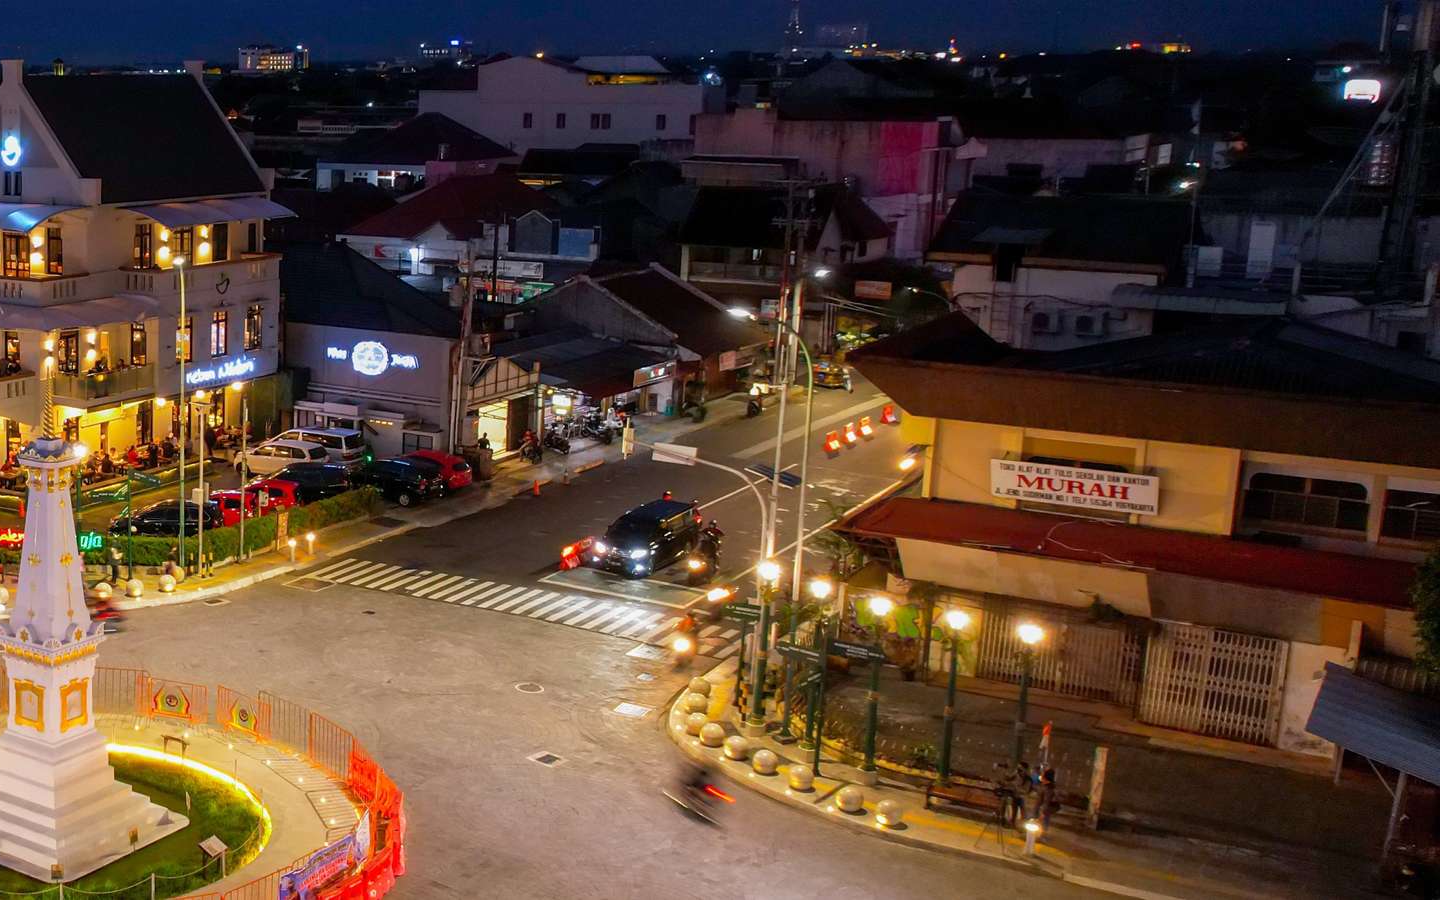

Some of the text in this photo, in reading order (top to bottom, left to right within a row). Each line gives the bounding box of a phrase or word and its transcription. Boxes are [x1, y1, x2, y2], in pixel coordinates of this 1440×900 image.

[1016, 474, 1130, 500] MURAH
[1076, 471, 1105, 481] SEKOLAH
[1123, 476, 1150, 486] KANTOR
